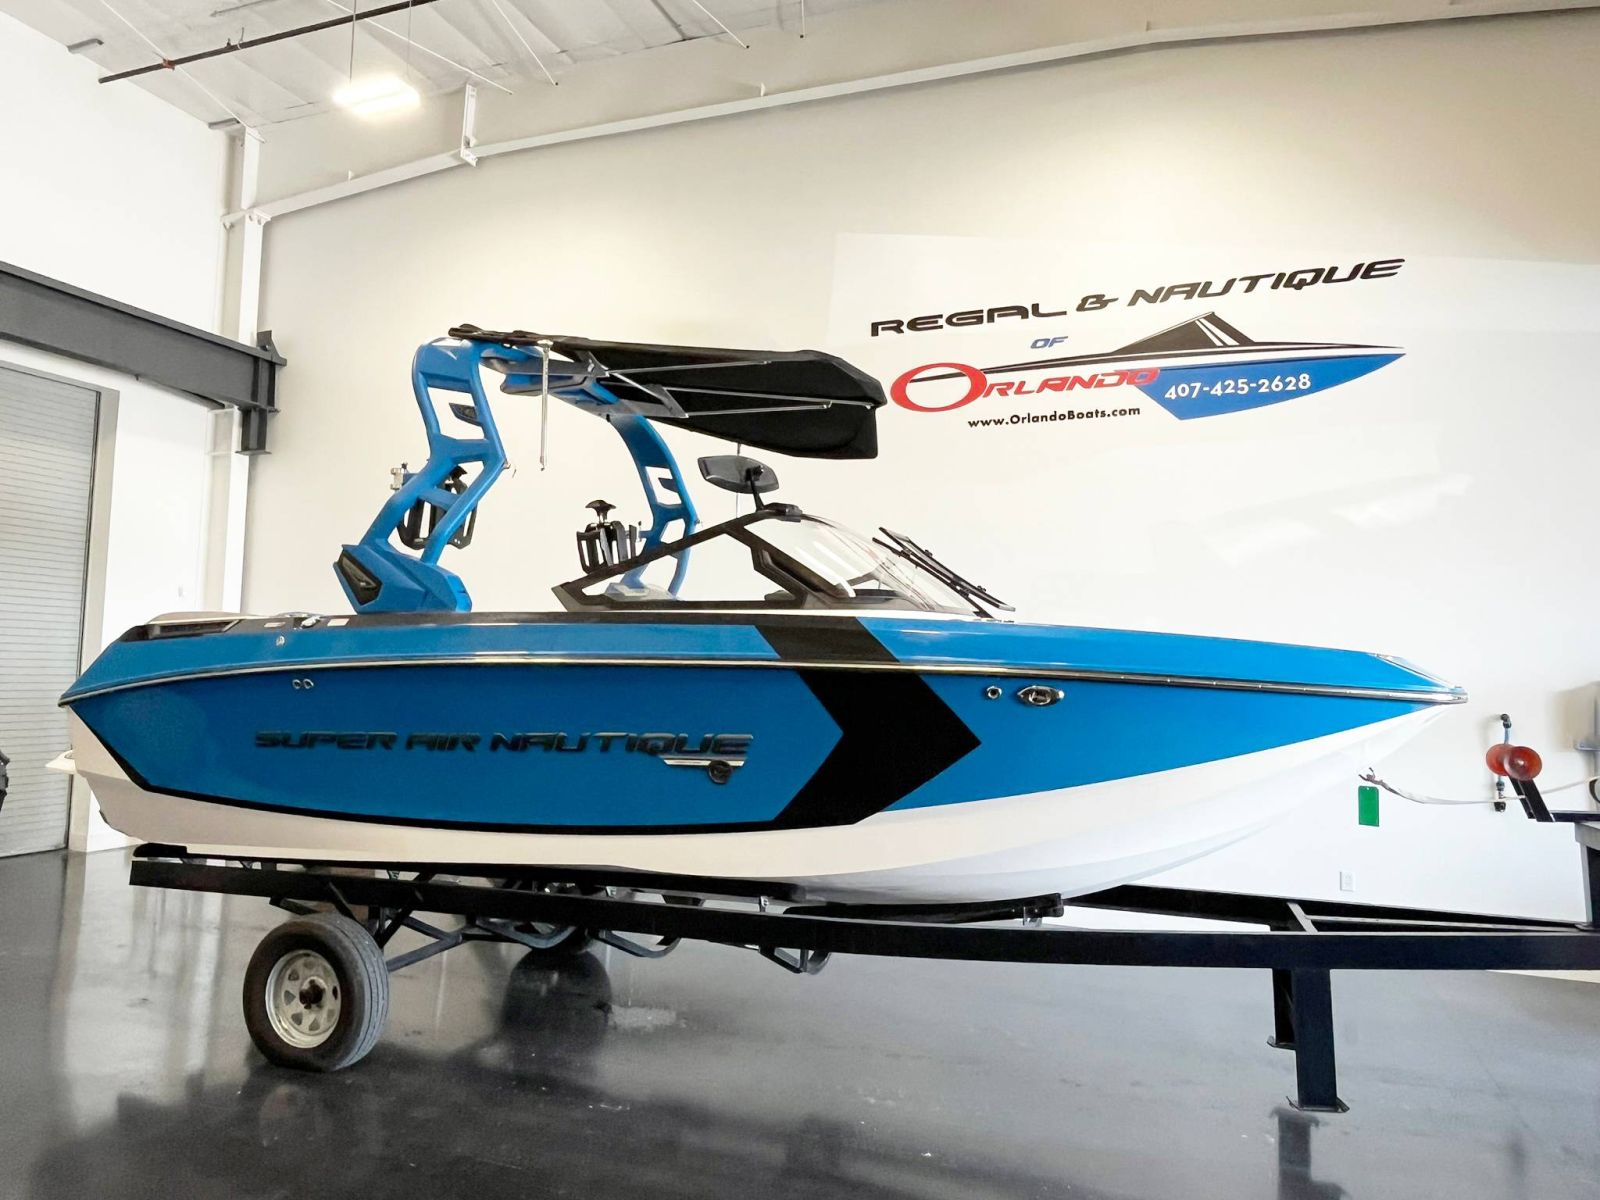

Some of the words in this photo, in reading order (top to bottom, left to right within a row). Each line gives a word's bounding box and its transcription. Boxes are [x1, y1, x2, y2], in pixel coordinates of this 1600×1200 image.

[870, 303, 1067, 337] REGAL
[1076, 294, 1119, 312] &
[1127, 258, 1406, 307] NAUTIQUE
[1030, 335, 1069, 349] OF
[1164, 373, 1312, 400] 407-425-2628
[967, 407, 1141, 428] www.OrlandoBoats.com
[255, 731, 398, 750] SUPER
[405, 732, 482, 751] AIR
[489, 731, 754, 757] NAUTIQUE
